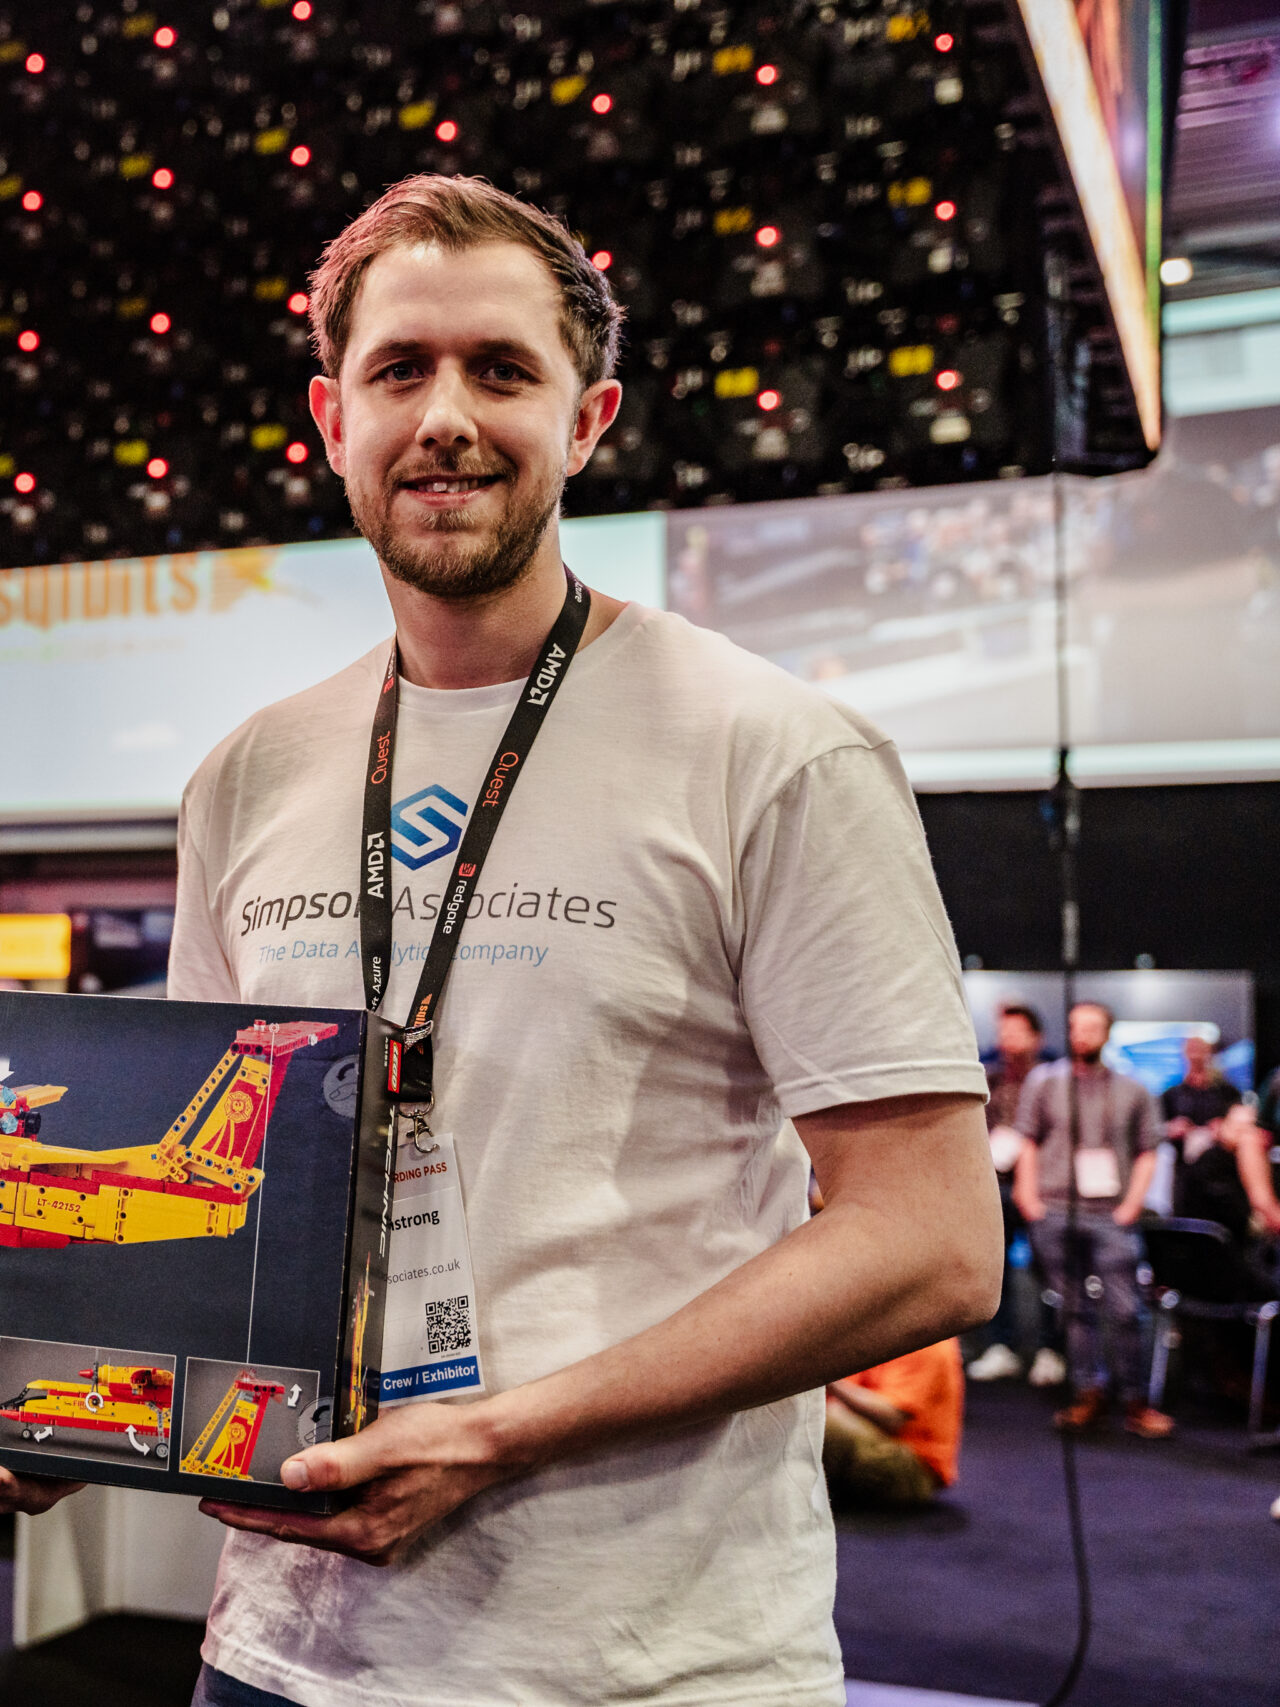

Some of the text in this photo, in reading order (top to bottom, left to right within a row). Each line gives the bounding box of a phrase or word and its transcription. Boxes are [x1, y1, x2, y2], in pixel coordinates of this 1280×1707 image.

[536, 643, 567, 690] AMD
[371, 731, 391, 784] Quest
[483, 752, 519, 807] Quest
[367, 850, 384, 898] AMD
[241, 883, 618, 936] Simpso Asociates
[443, 880, 467, 934] redgate
[259, 945, 286, 963] The
[292, 940, 339, 959] Data
[373, 956, 382, 994] Azure
[379, 1105, 395, 1258] TECHNIC
[394, 1162, 448, 1183] RDING PASS
[391, 1210, 440, 1231] strong
[387, 1258, 461, 1284] sociates.co.uk
[383, 1375, 413, 1391] Crew
[422, 1365, 476, 1383] Exhibitor
